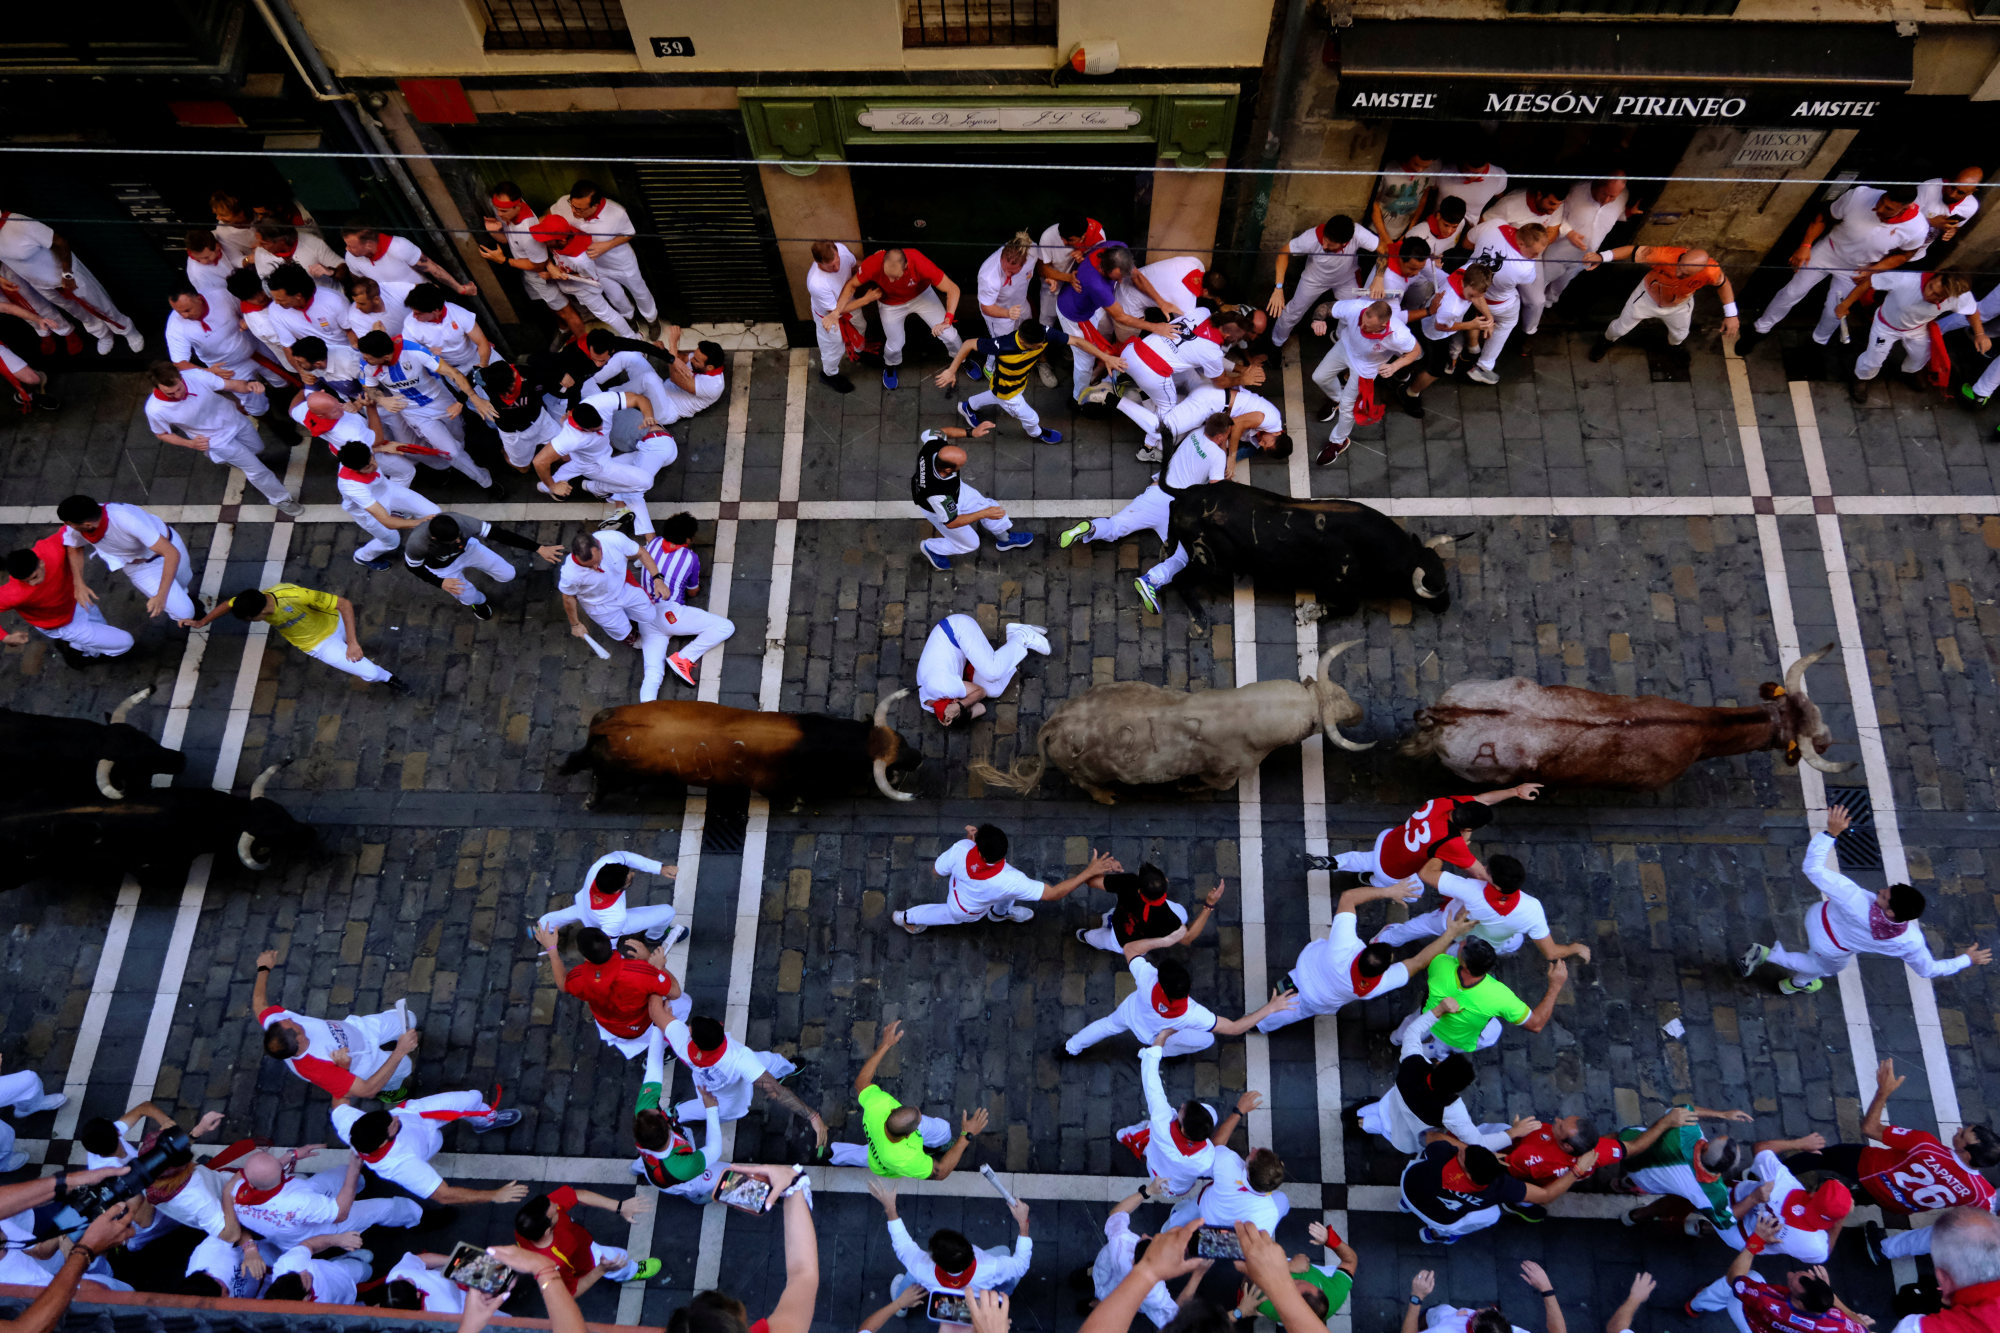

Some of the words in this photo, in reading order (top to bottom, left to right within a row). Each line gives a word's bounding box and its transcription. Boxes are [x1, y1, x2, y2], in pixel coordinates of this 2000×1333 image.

[659, 41, 684, 55] 39
[1352, 92, 1434, 109] AMSTEL
[1484, 90, 1603, 115] MESÓN
[1612, 96, 1747, 117] PIRINEO
[1791, 101, 1876, 117] AMSTEL
[891, 112, 925, 126] Taller
[1738, 149, 1806, 162] PIRINEO
[1923, 1154, 1972, 1198] ZAPATER
[1892, 1162, 1958, 1209] 26
[1436, 1195, 1463, 1212] 4
[1448, 1189, 1484, 1207] UIZ
